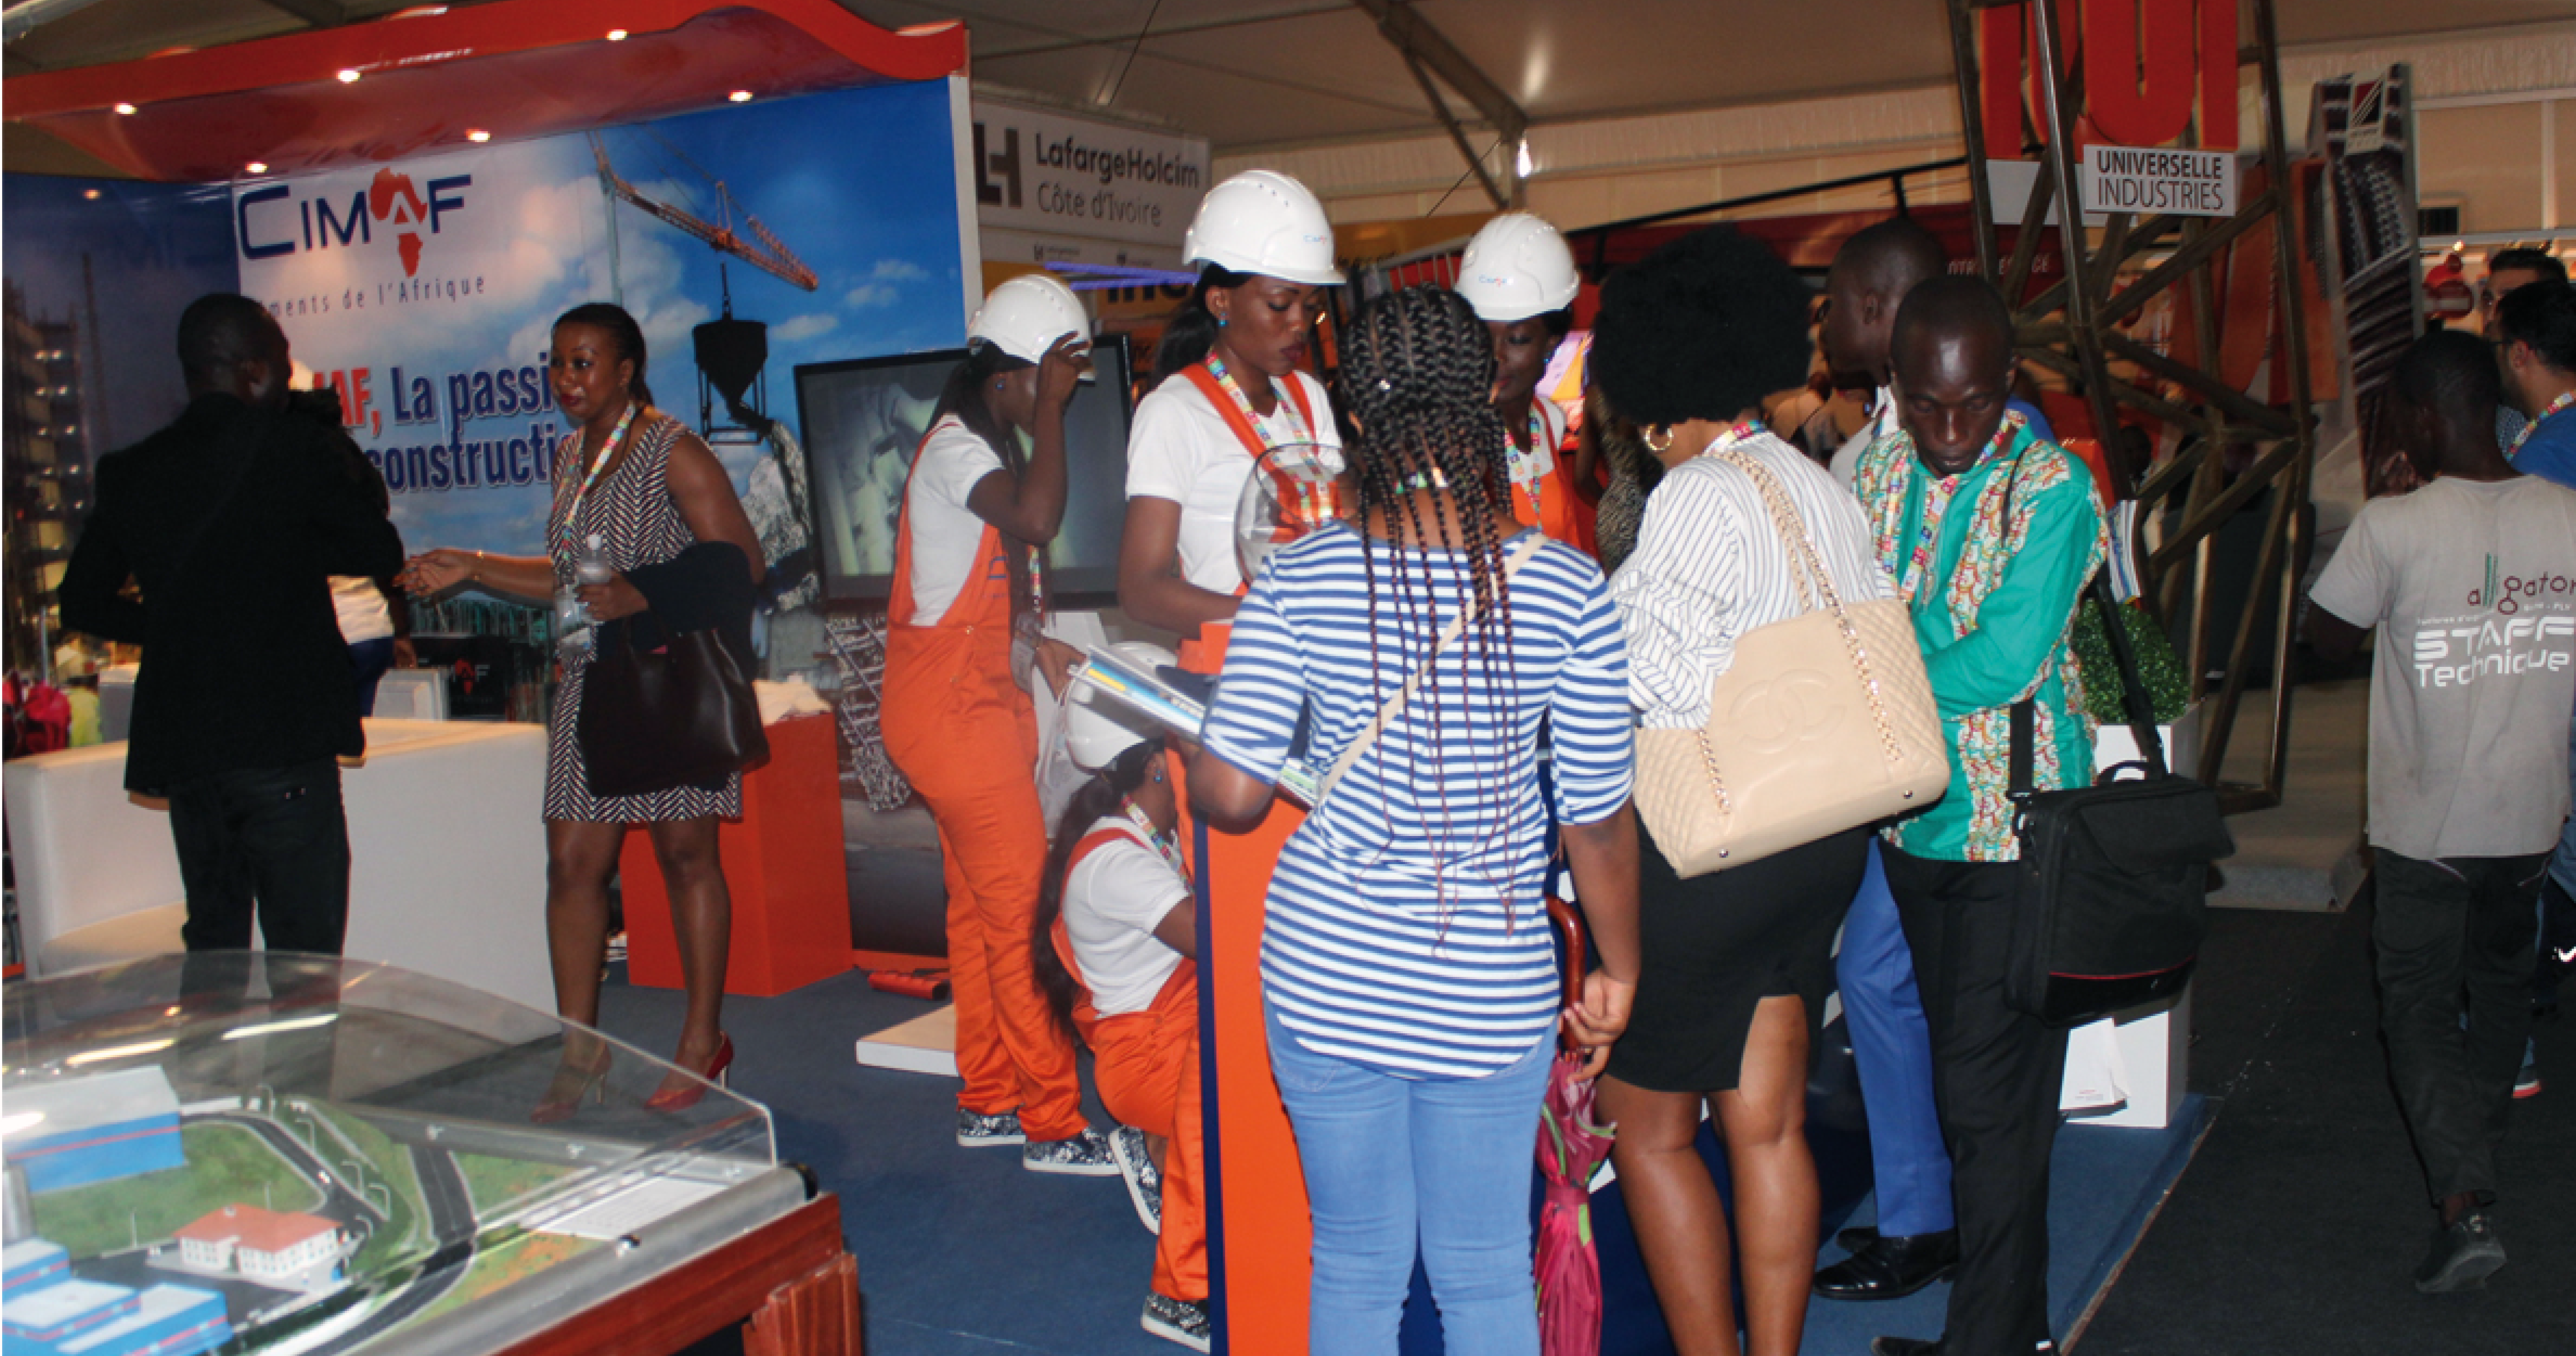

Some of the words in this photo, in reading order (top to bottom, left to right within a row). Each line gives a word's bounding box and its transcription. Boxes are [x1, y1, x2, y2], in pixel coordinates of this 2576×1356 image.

[1036, 133, 1199, 188] LafargeHolcim
[2097, 150, 2222, 180] UNIVERSELLE
[1037, 182, 1087, 219] Côte
[1093, 189, 1161, 227] d'Ivoire
[2098, 178, 2224, 210] INDUSTRIES
[268, 294, 329, 317] ments
[342, 287, 365, 310] de
[378, 275, 486, 306] l'Afrique
[390, 365, 438, 426] La
[448, 350, 552, 432] passi
[2414, 616, 2574, 661] STAFF
